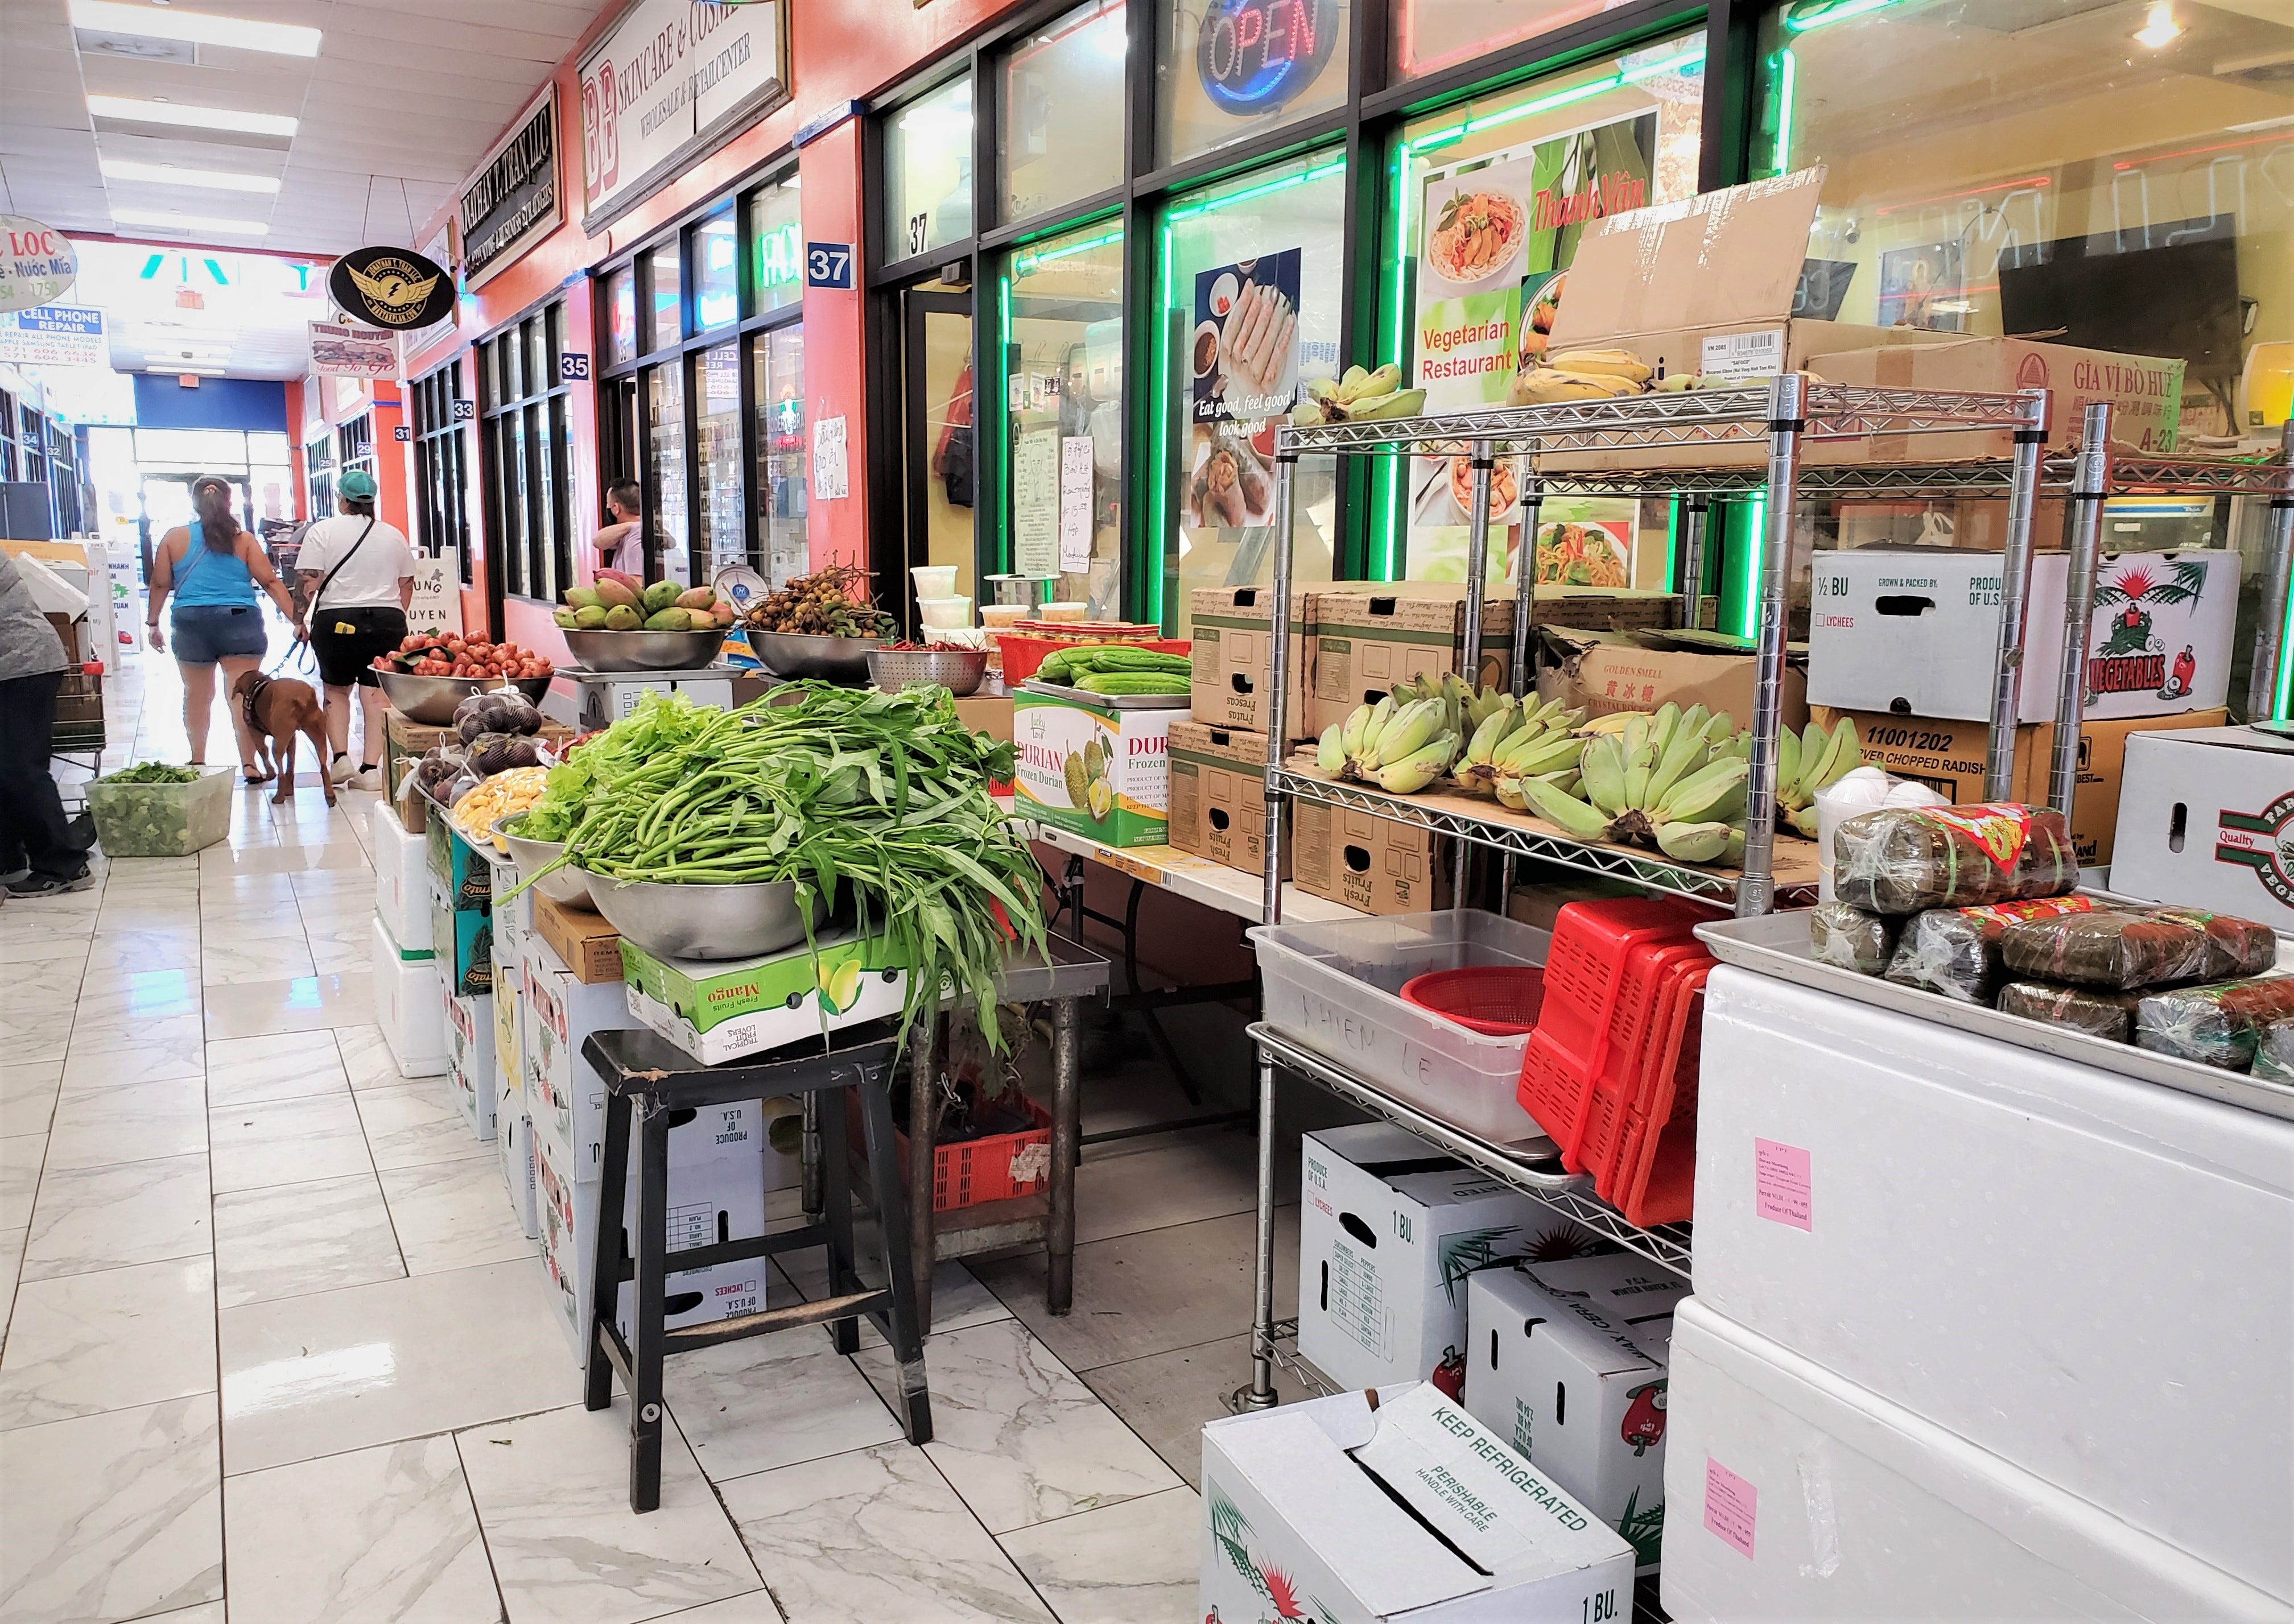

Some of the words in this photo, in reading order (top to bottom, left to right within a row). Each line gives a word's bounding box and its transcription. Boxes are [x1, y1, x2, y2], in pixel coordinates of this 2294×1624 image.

[1209, 0, 1319, 81] OPEN
[617, 21, 674, 115] SKINCARE
[640, 86, 680, 141] WHOLESALE
[461, 168, 492, 237] ONATHAN
[1534, 177, 1600, 232] Thanh
[910, 213, 928, 254] 37
[9, 230, 56, 256] LOC
[809, 250, 850, 282] 37
[22, 308, 52, 320] CELL
[55, 311, 100, 324] PHONE
[39, 320, 86, 332] REPAIR
[1423, 319, 1509, 352] Vegetarian
[344, 363, 362, 373] To
[366, 362, 395, 376] Go
[562, 357, 588, 377] 35
[1422, 349, 1512, 381] Restaurant
[454, 402, 474, 418] 33
[1199, 400, 1214, 416] Eat
[1216, 400, 1241, 418] good,
[1244, 394, 1262, 413] feel
[1264, 390, 1291, 412] good
[395, 429, 410, 440] 31
[1219, 420, 1238, 437] look
[1241, 418, 1266, 438] good
[23, 434, 38, 445] 34
[2139, 427, 2173, 452] A-23
[47, 447, 61, 456] 32
[357, 444, 371, 455] 29
[413, 580, 442, 593] UNG
[1831, 577, 1849, 597] BU
[1878, 578, 1898, 588] GROWN
[1905, 579, 1928, 588] PACKED
[1970, 577, 2002, 591] PRODU
[1969, 592, 1980, 605] OF
[1983, 593, 1999, 606] U.S
[409, 609, 447, 620] UYEN
[1826, 615, 1854, 628] LYCHEES
[1604, 664, 1636, 676] GOLDEN
[2089, 655, 2166, 694] VEGETABLES
[1227, 696, 1256, 712] Frescas
[1228, 710, 1255, 725] Frutas
[1128, 736, 1169, 756] DUR
[1867, 726, 1954, 753] 11001202
[1017, 741, 1063, 773] DURIAN
[1128, 758, 1166, 770] Frozen
[1885, 752, 1940, 770] CHOPPED
[1017, 764, 1038, 783] Frozen
[1038, 771, 1063, 790] Durian
[1209, 832, 1231, 848] Fruits
[2219, 830, 2255, 848] Quality
[1210, 844, 1231, 861] Fresh
[1342, 872, 1372, 893] Fruits
[1344, 887, 1372, 907] Fresh
[707, 981, 760, 1003] Mango
[736, 995, 758, 1007] Fresh
[712, 999, 735, 1012] Fruits
[727, 1024, 756, 1038] LOVERS
[735, 1031, 757, 1043] FRUIT
[723, 1037, 759, 1052] TROPICAL
[720, 1109, 742, 1121] U.S.A.
[726, 1121, 736, 1131] OF
[715, 1130, 748, 1145] PRODUCE
[1307, 1156, 1328, 1179] PRODUCE
[1307, 1170, 1314, 1183] OF
[1313, 1173, 1327, 1192] U.S.A.
[1315, 1196, 1334, 1218] LYCHEES
[1393, 1209, 1397, 1234] 1
[1399, 1213, 1414, 1246] BU.
[1360, 1257, 1376, 1274] PEPPERS
[715, 1283, 744, 1296] LYCHEES
[725, 1298, 747, 1310] U.S.A.
[746, 1296, 757, 1306] OF
[1431, 1406, 1475, 1439] KEEP
[1468, 1437, 1588, 1532] REFRIGERATED
[1414, 1468, 1449, 1498] HANDLE
[1446, 1494, 1468, 1514] WITH
[1463, 1510, 1490, 1533] CARE
[1430, 1465, 1498, 1522] PERISHABLE
[1594, 1588, 1618, 1623] BU.
